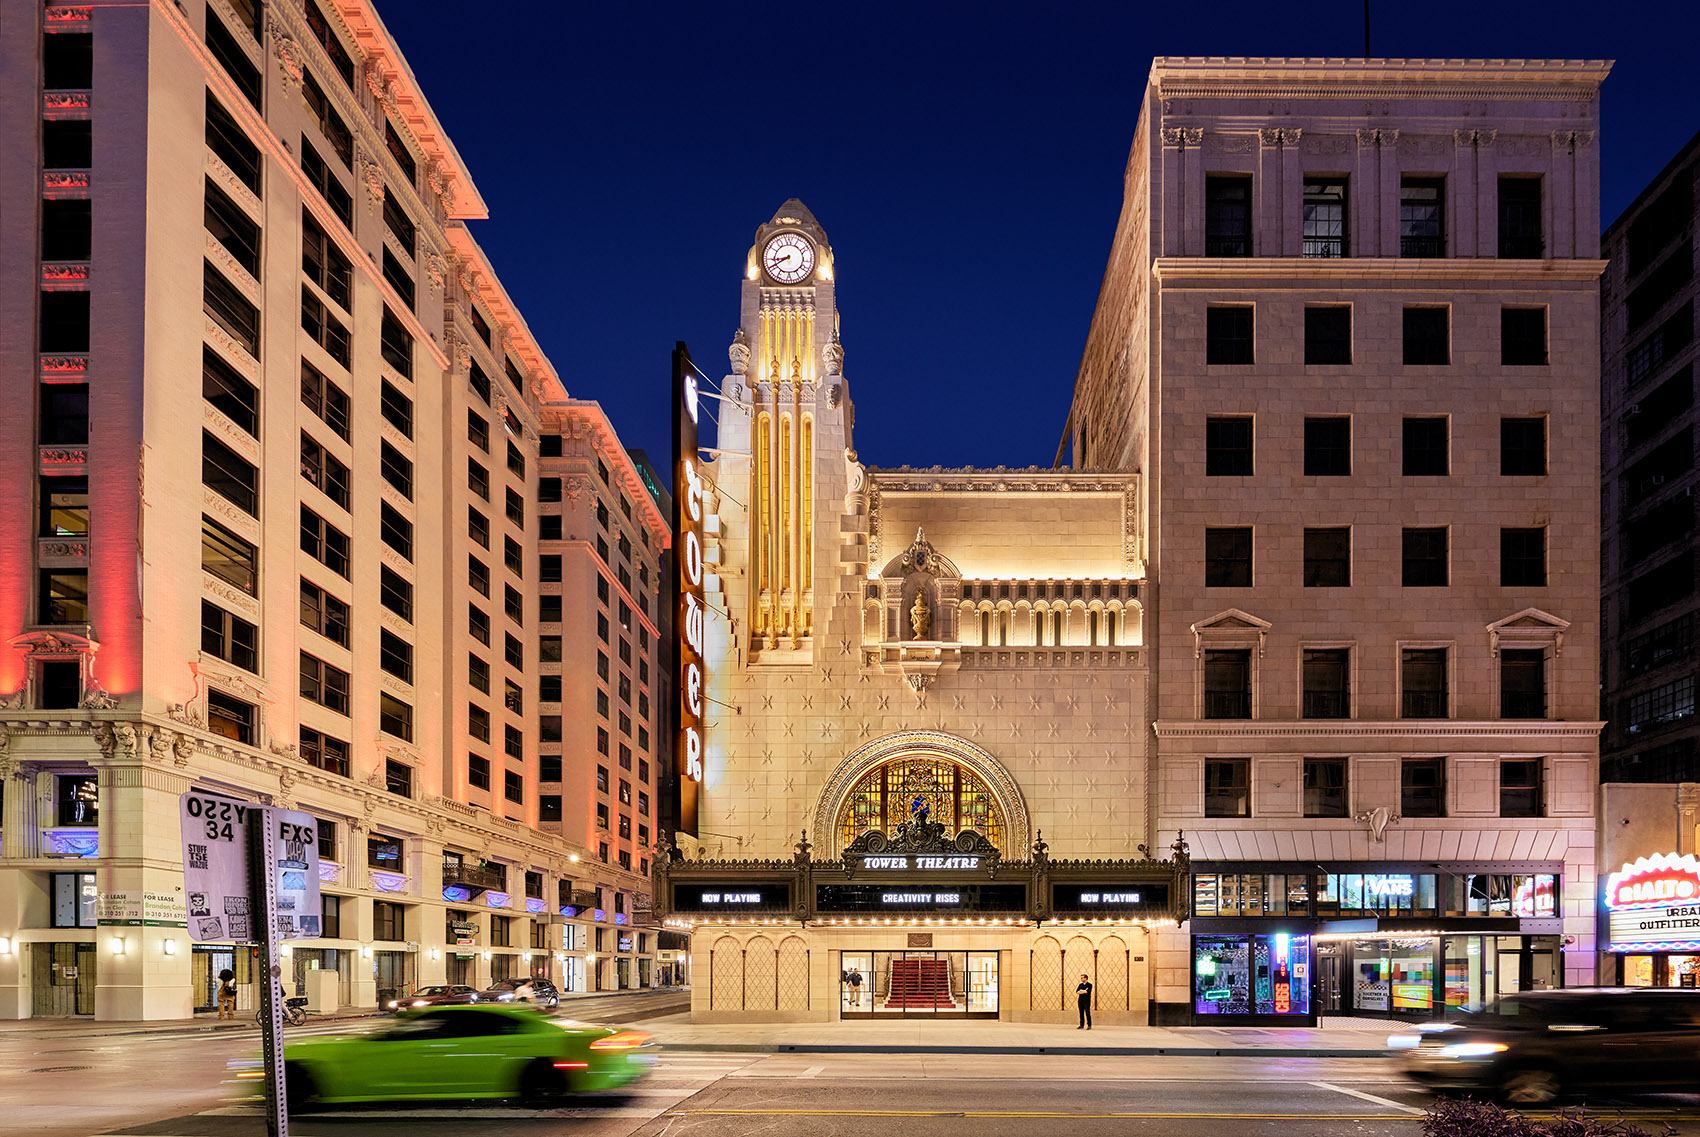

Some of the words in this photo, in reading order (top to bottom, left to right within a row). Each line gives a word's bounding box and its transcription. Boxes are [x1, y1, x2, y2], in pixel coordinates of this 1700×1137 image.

[205, 820, 234, 842] 34
[280, 821, 314, 845] FXS
[188, 844, 207, 854] STUFF
[863, 857, 908, 869] TOWER
[915, 857, 979, 869] THEATRE
[1369, 879, 1413, 896] VANS
[1618, 879, 1694, 903] RIALTO
[702, 893, 720, 903] NOW
[724, 893, 761, 903] PLAYING
[882, 893, 932, 903] CREATIVITY
[935, 893, 960, 903] RISES
[1080, 893, 1099, 903] NOW
[1102, 893, 1140, 903] PLAYING
[1666, 906, 1700, 917] URBA
